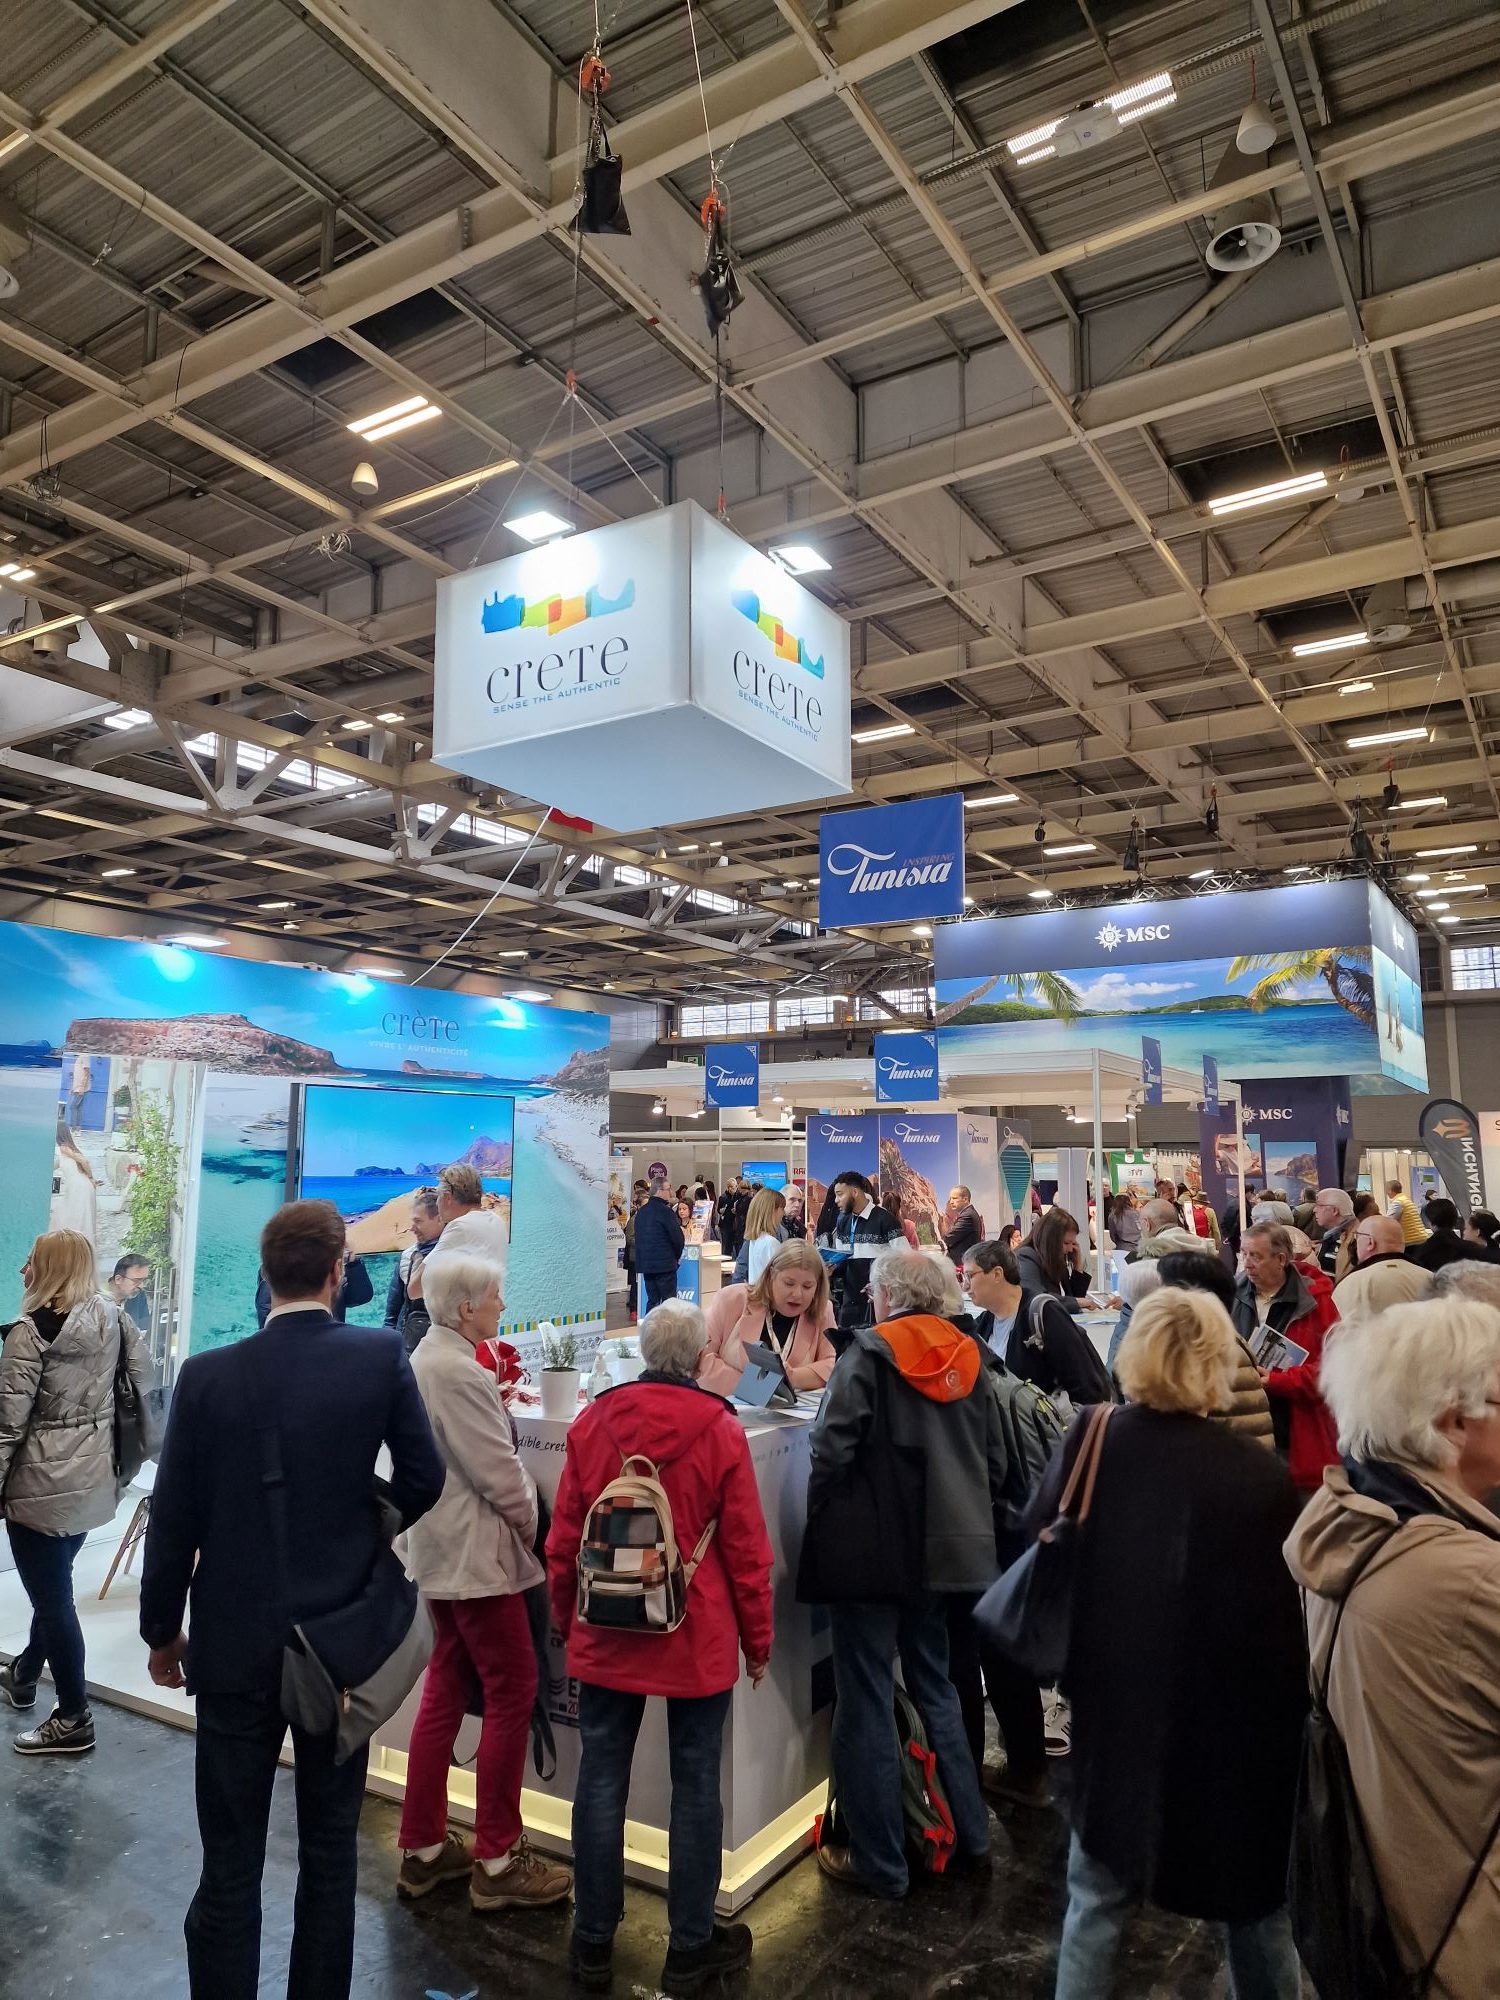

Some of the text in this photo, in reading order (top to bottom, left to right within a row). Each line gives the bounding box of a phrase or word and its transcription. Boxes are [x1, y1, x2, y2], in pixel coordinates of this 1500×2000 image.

[492, 677, 621, 714] SENSE THE AUTHENTIC
[738, 689, 819, 742] SENSE THE AUTHENTIC
[827, 843, 953, 894] Tunisia
[1125, 924, 1171, 943] MSC
[708, 1065, 755, 1087] Tunisia
[878, 1056, 935, 1080] Tunisia
[1259, 1108, 1293, 1120] MSC
[820, 1123, 864, 1144] Tunisia
[894, 1122, 941, 1143] Tunisia
